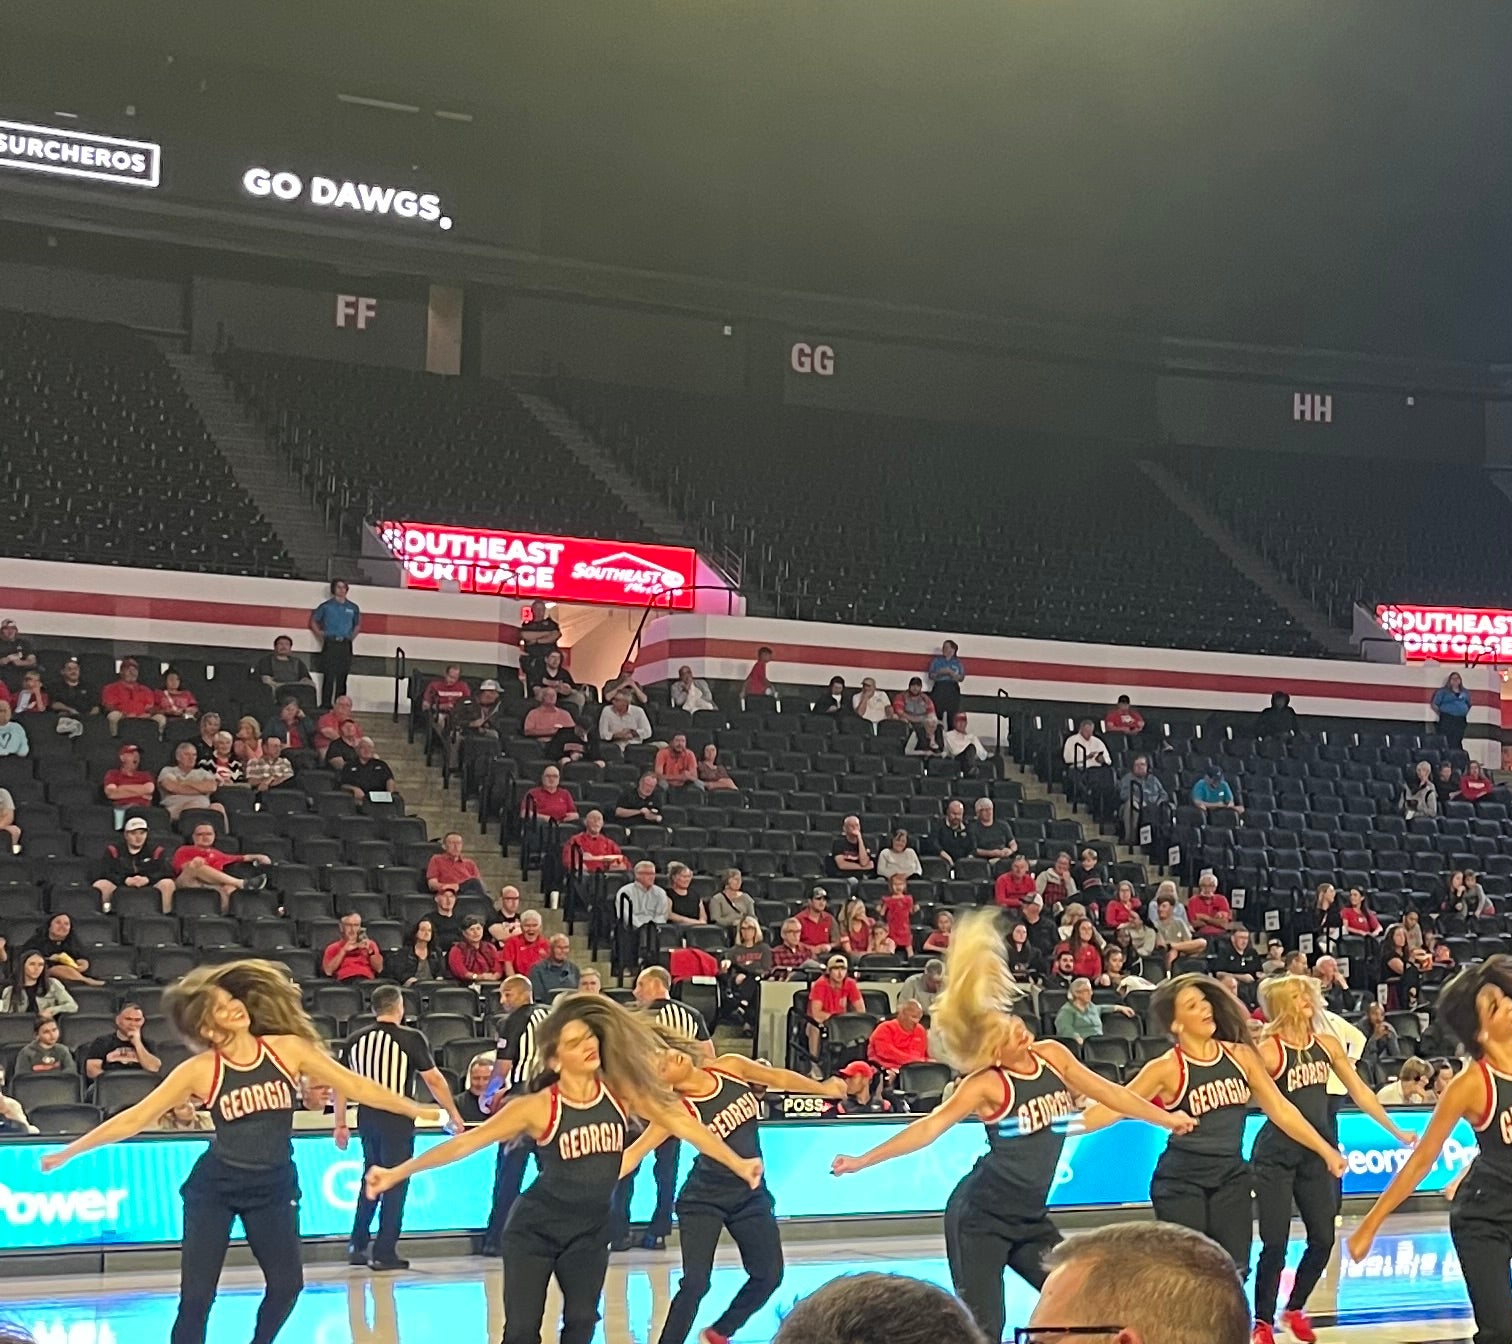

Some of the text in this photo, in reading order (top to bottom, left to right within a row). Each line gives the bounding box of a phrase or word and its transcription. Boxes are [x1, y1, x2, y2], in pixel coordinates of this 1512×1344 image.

[0, 133, 146, 173] SURCHEROS
[243, 167, 302, 200] GO
[336, 294, 377, 329] FF
[791, 343, 834, 375] GG
[1293, 393, 1332, 422] HH
[403, 556, 555, 589] ORTGAGE
[219, 1080, 292, 1122] GEORGIA
[783, 1098, 824, 1113] POSS
[559, 1122, 623, 1160] GEORGIA
